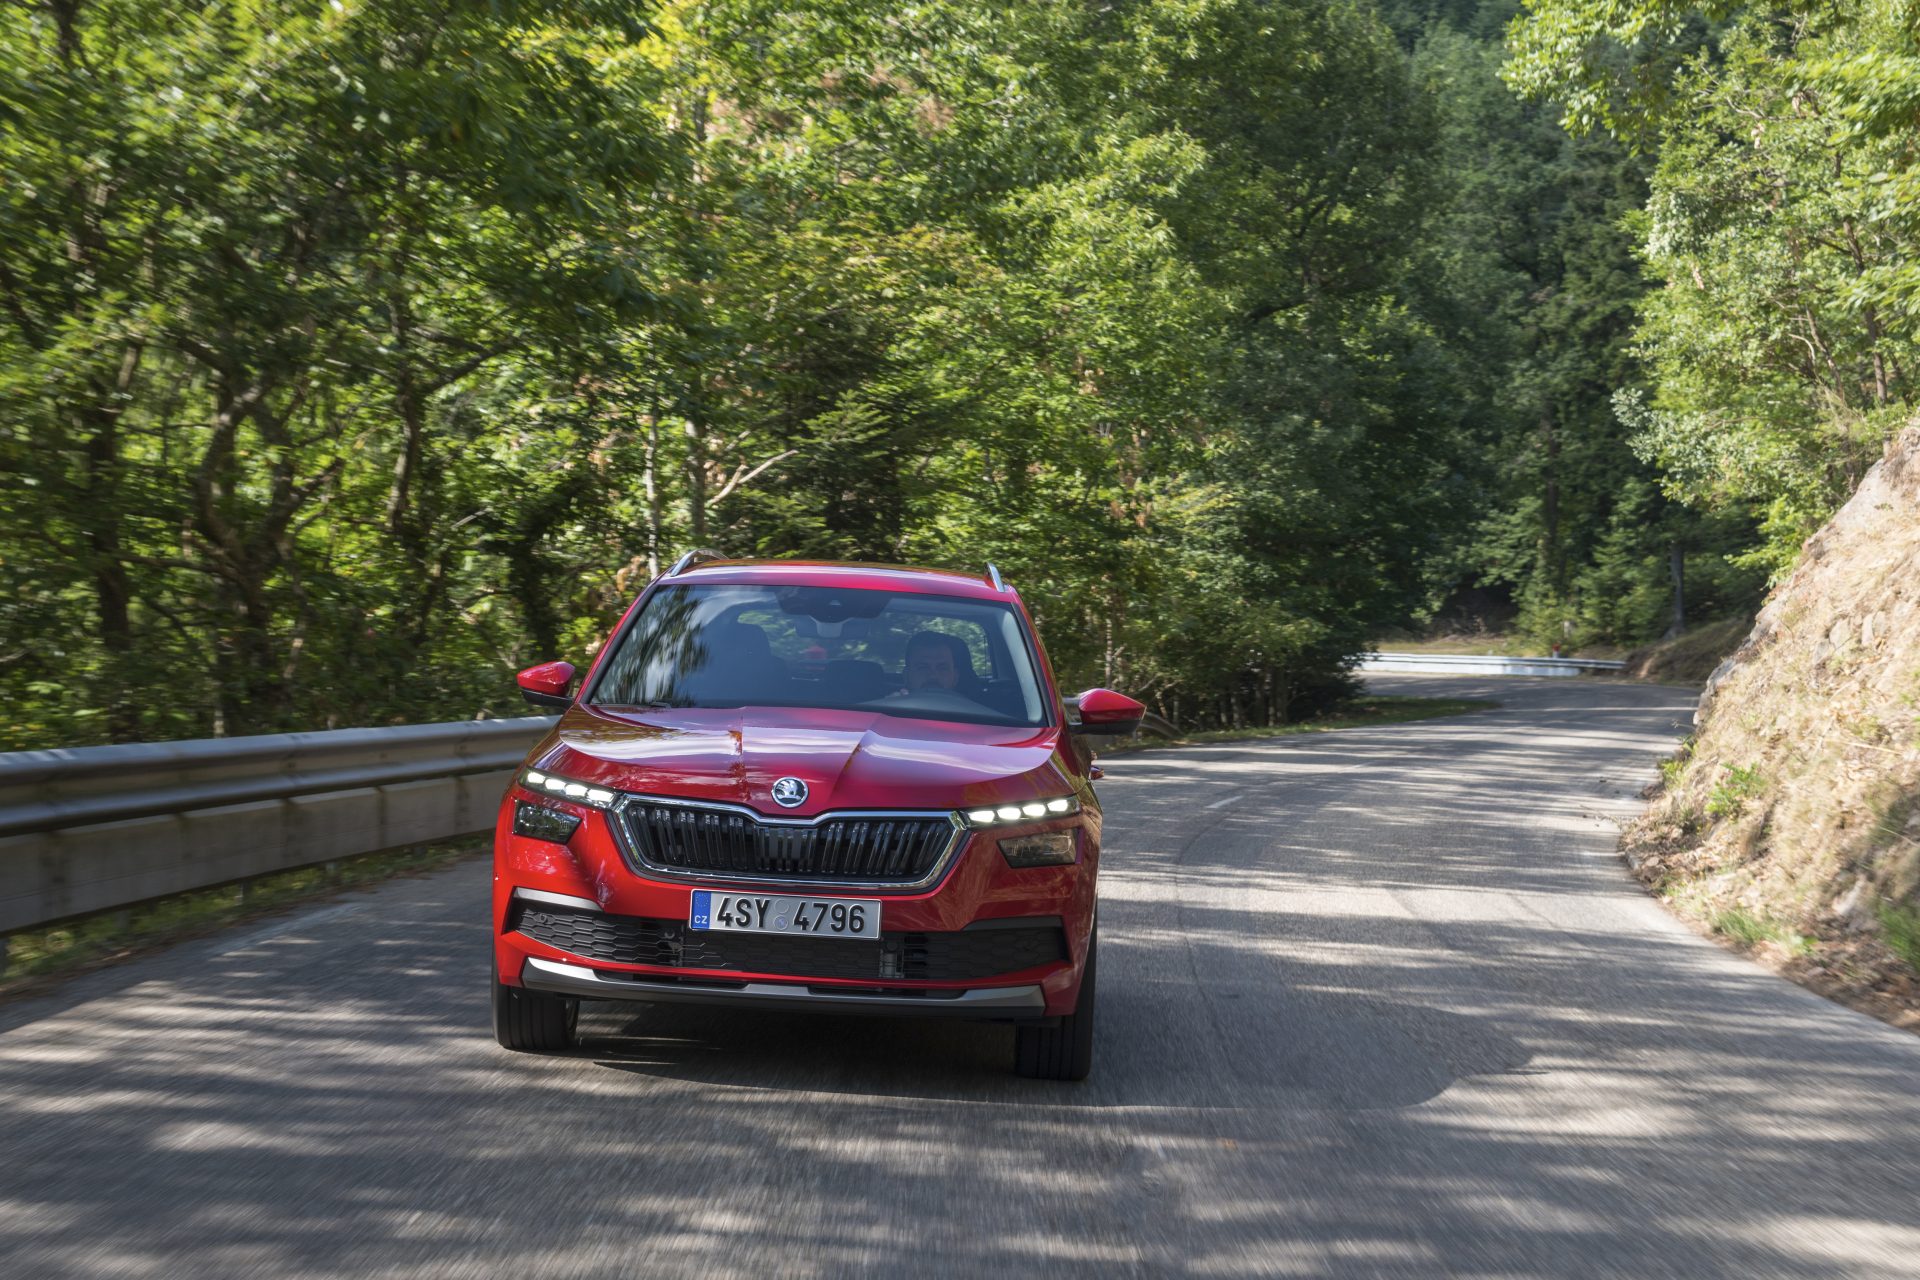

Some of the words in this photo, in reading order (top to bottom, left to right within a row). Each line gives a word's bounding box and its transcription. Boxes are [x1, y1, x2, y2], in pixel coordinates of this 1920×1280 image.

[694, 914, 708, 925] CZ
[716, 897, 770, 927] 4SY
[793, 901, 865, 933] 4796
